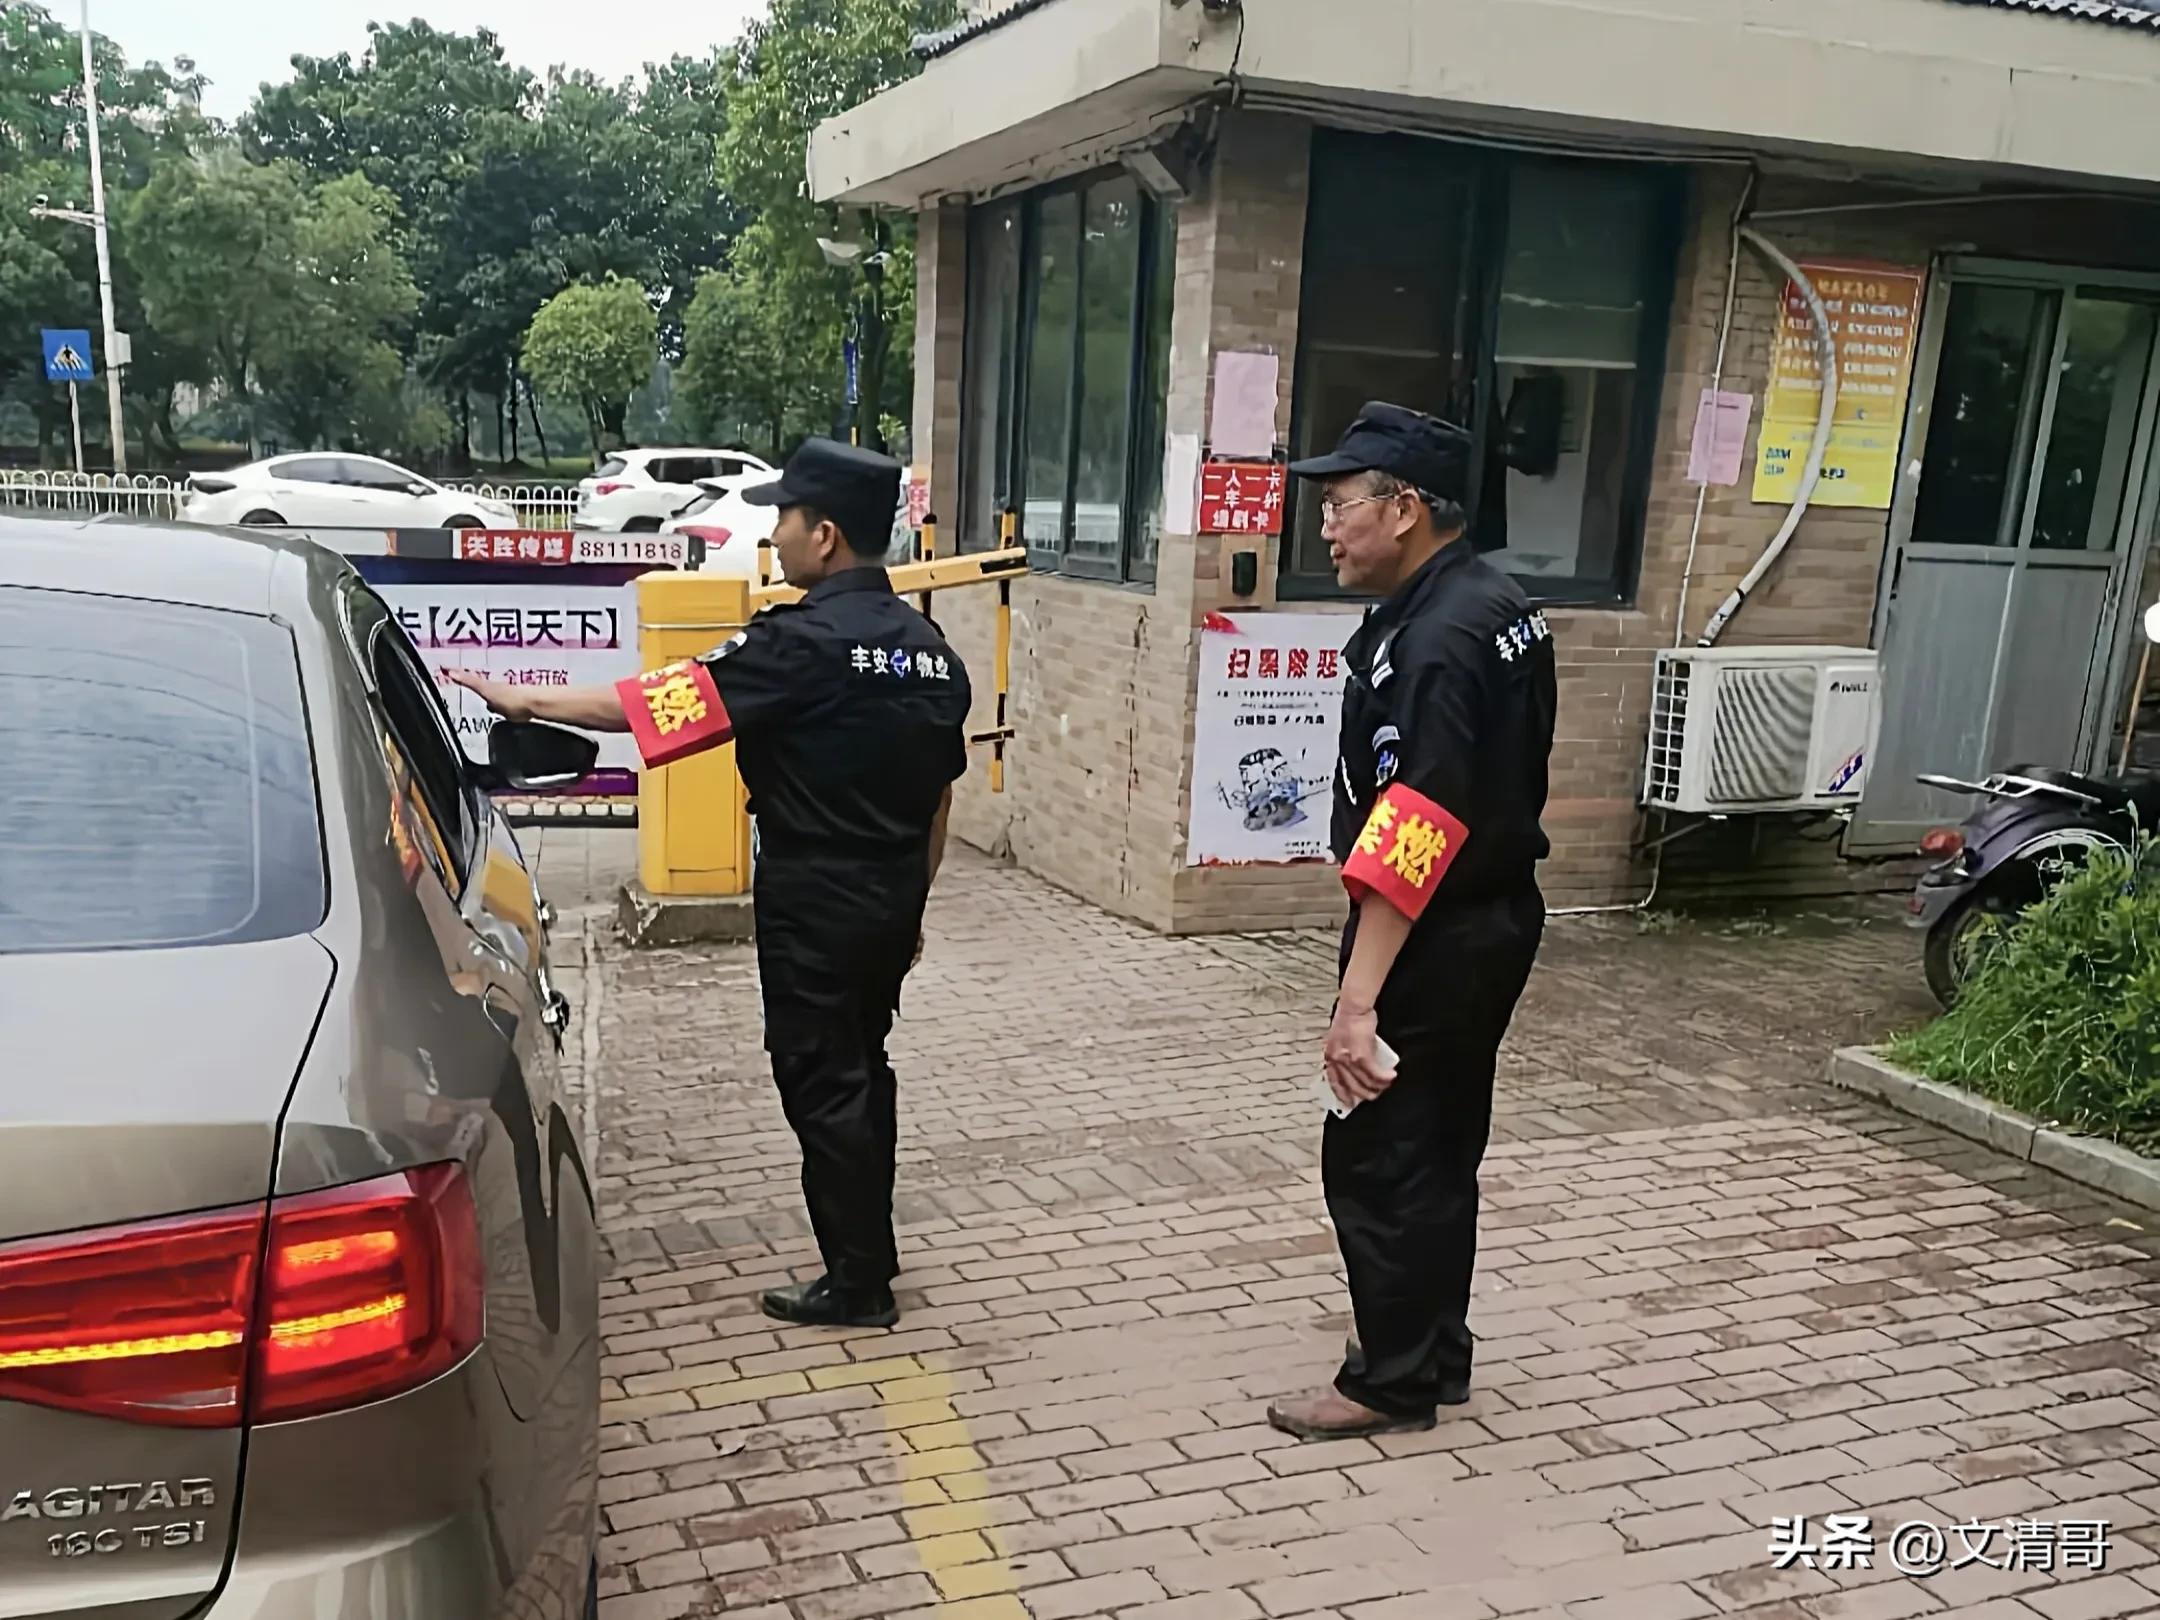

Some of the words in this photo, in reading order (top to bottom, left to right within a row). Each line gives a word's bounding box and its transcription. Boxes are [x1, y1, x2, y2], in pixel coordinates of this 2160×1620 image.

[1205, 466, 1281, 490] 一人一卡
[579, 540, 683, 560] 88111818
[1227, 648, 1339, 679] 扫黑除恶
